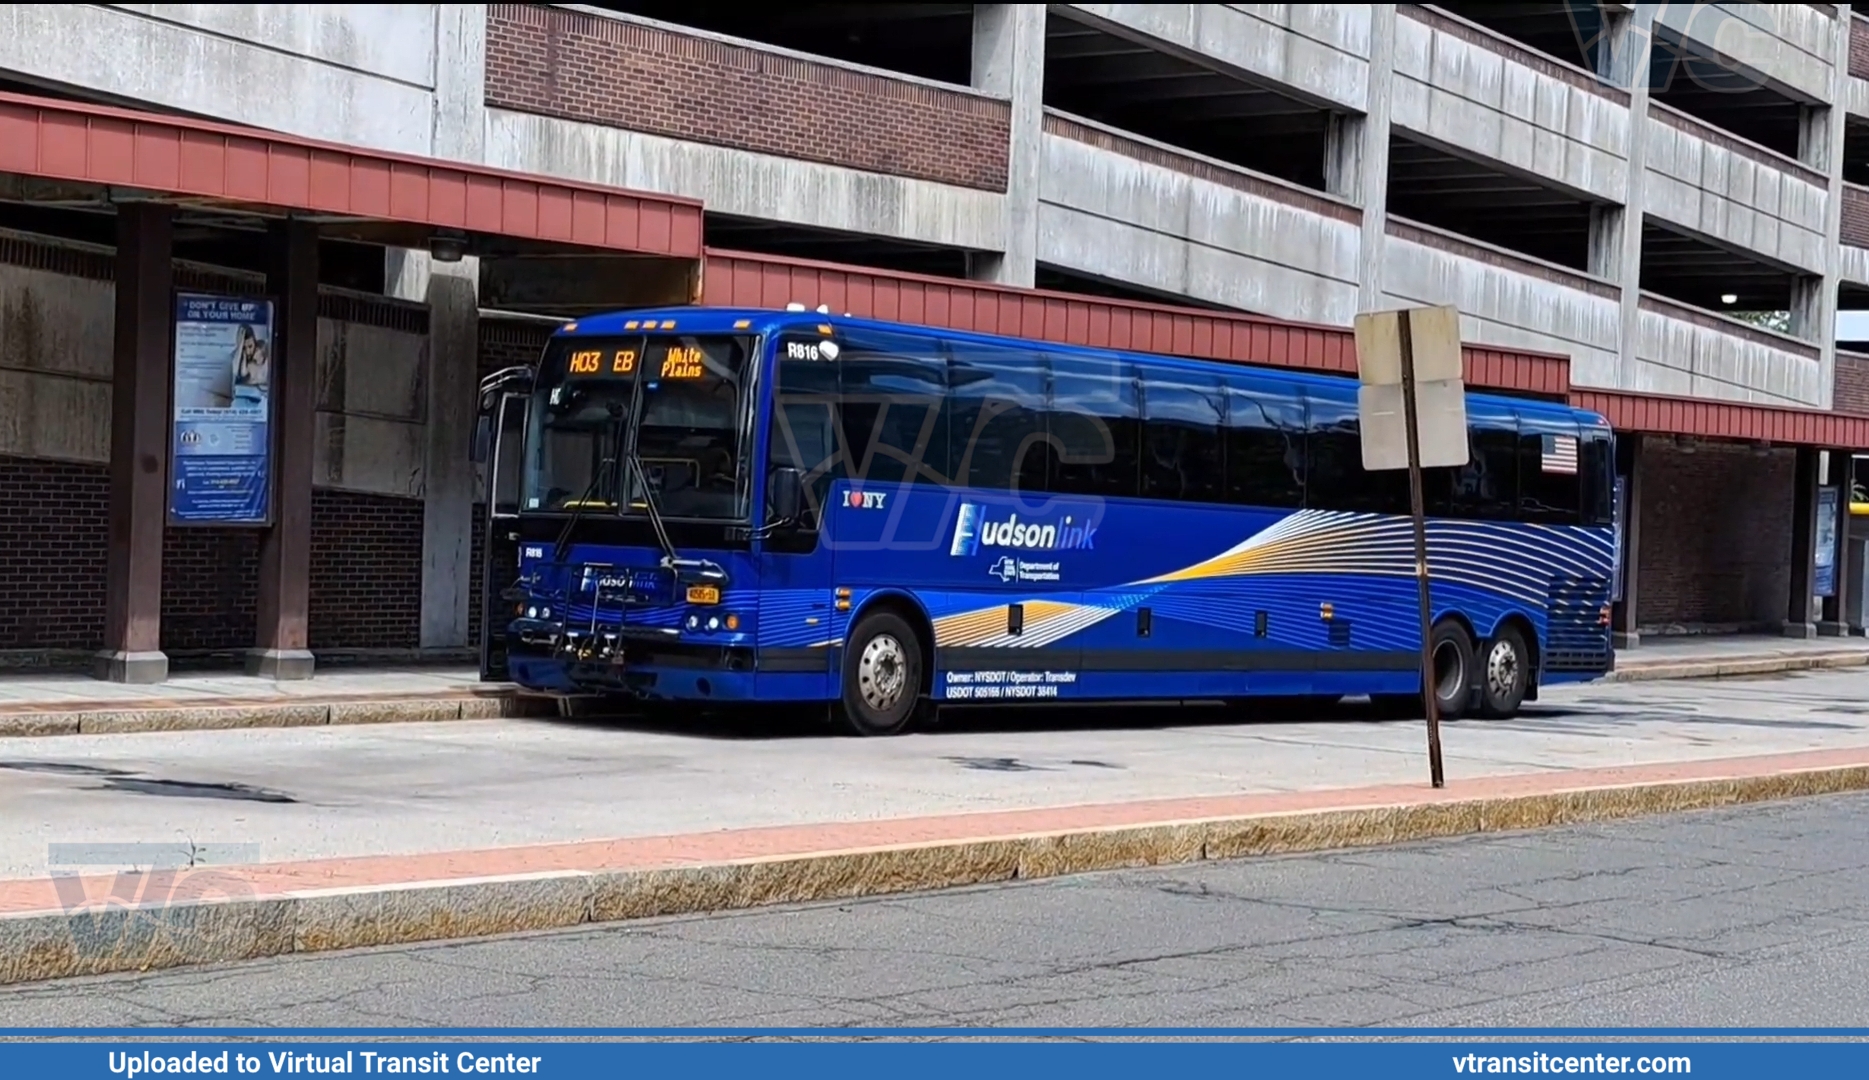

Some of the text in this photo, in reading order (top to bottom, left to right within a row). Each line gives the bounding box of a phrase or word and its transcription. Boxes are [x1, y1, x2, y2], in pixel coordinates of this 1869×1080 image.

[667, 347, 701, 363] White
[787, 342, 818, 361] R816
[612, 350, 635, 372] EB
[661, 361, 702, 378] Plains
[950, 503, 1098, 556] Hudsonlink
[946, 671, 974, 683] Owner:
[974, 671, 1006, 683] NYSDOT
[1045, 671, 1076, 683] Transdev
[946, 686, 974, 698] USDOT
[1005, 685, 1037, 698] NYSDOT
